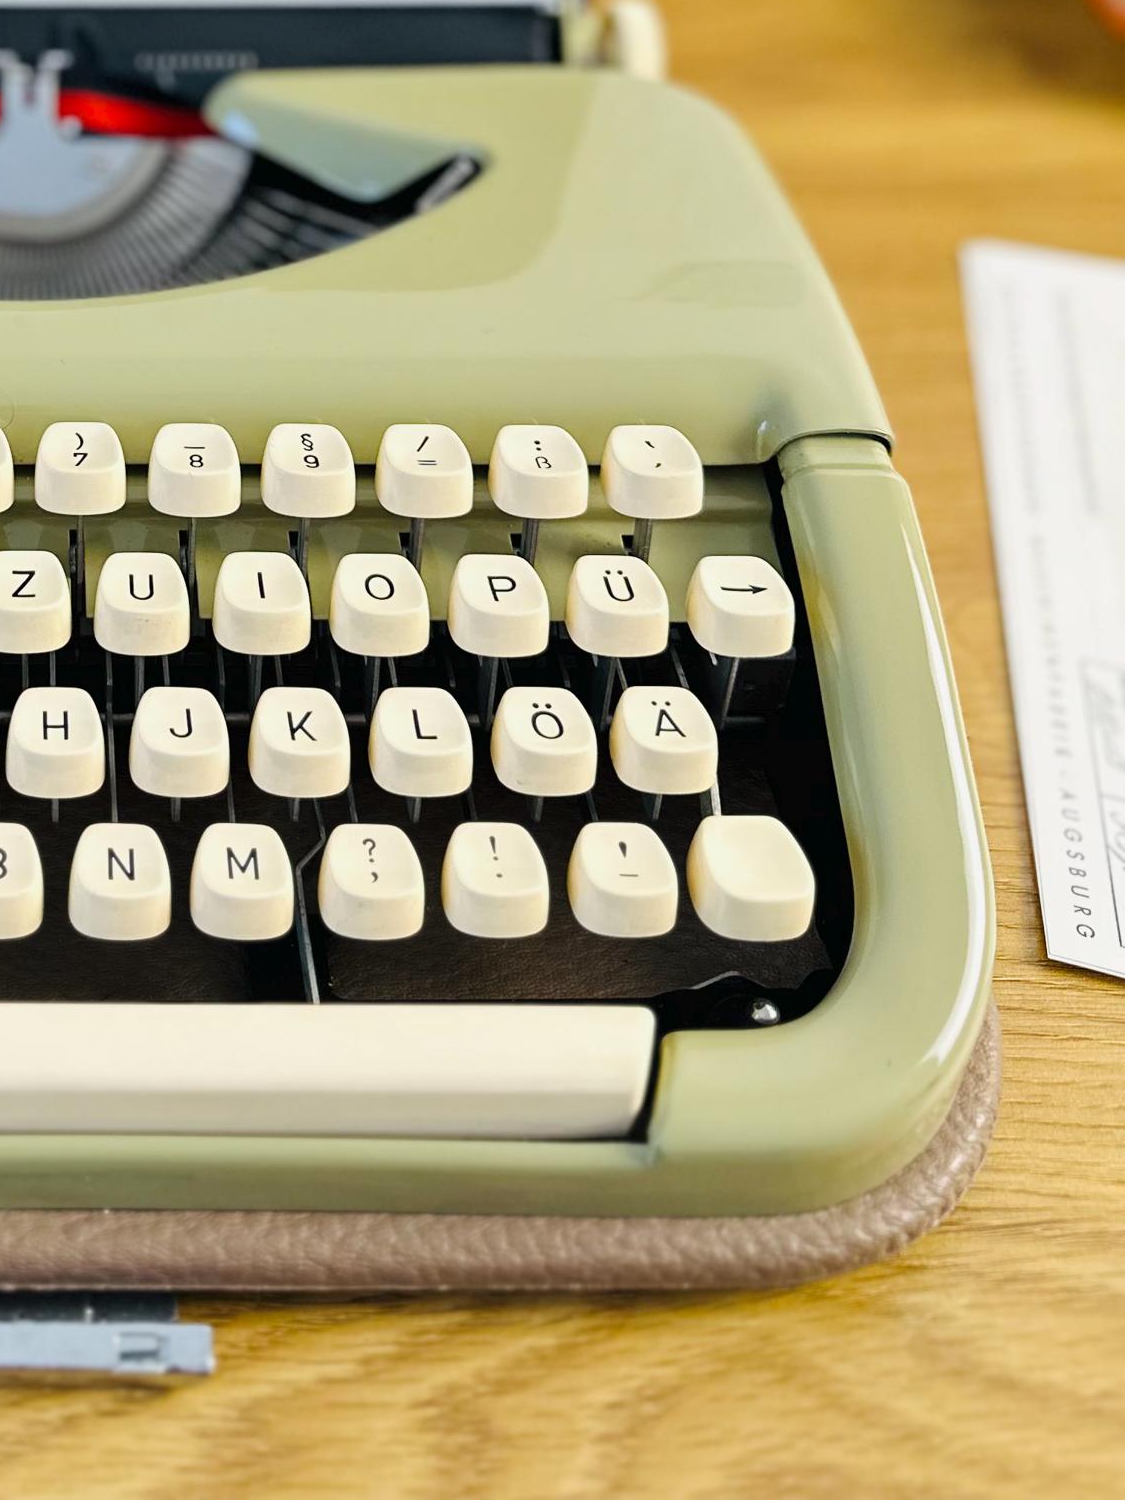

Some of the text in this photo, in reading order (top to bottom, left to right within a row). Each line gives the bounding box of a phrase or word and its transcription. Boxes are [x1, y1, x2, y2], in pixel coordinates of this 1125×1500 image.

[72, 452, 89, 467] 7
[188, 453, 205, 469] 8
[303, 454, 320, 469] 9
[11, 569, 37, 599] Z
[128, 573, 155, 601] U
[256, 571, 266, 600] I
[364, 573, 395, 601] O
[486, 575, 517, 603] P
[602, 568, 635, 603] Ü
[42, 710, 69, 741] H
[168, 707, 193, 739] J
[286, 710, 318, 742] K
[411, 708, 439, 740] L
[530, 701, 565, 740] Ö
[650, 699, 687, 738] Ä
[107, 847, 136, 882] N
[226, 846, 260, 881] M
[362, 837, 377, 864] ?
[1060, 786, 1095, 939] AUGSBURG
